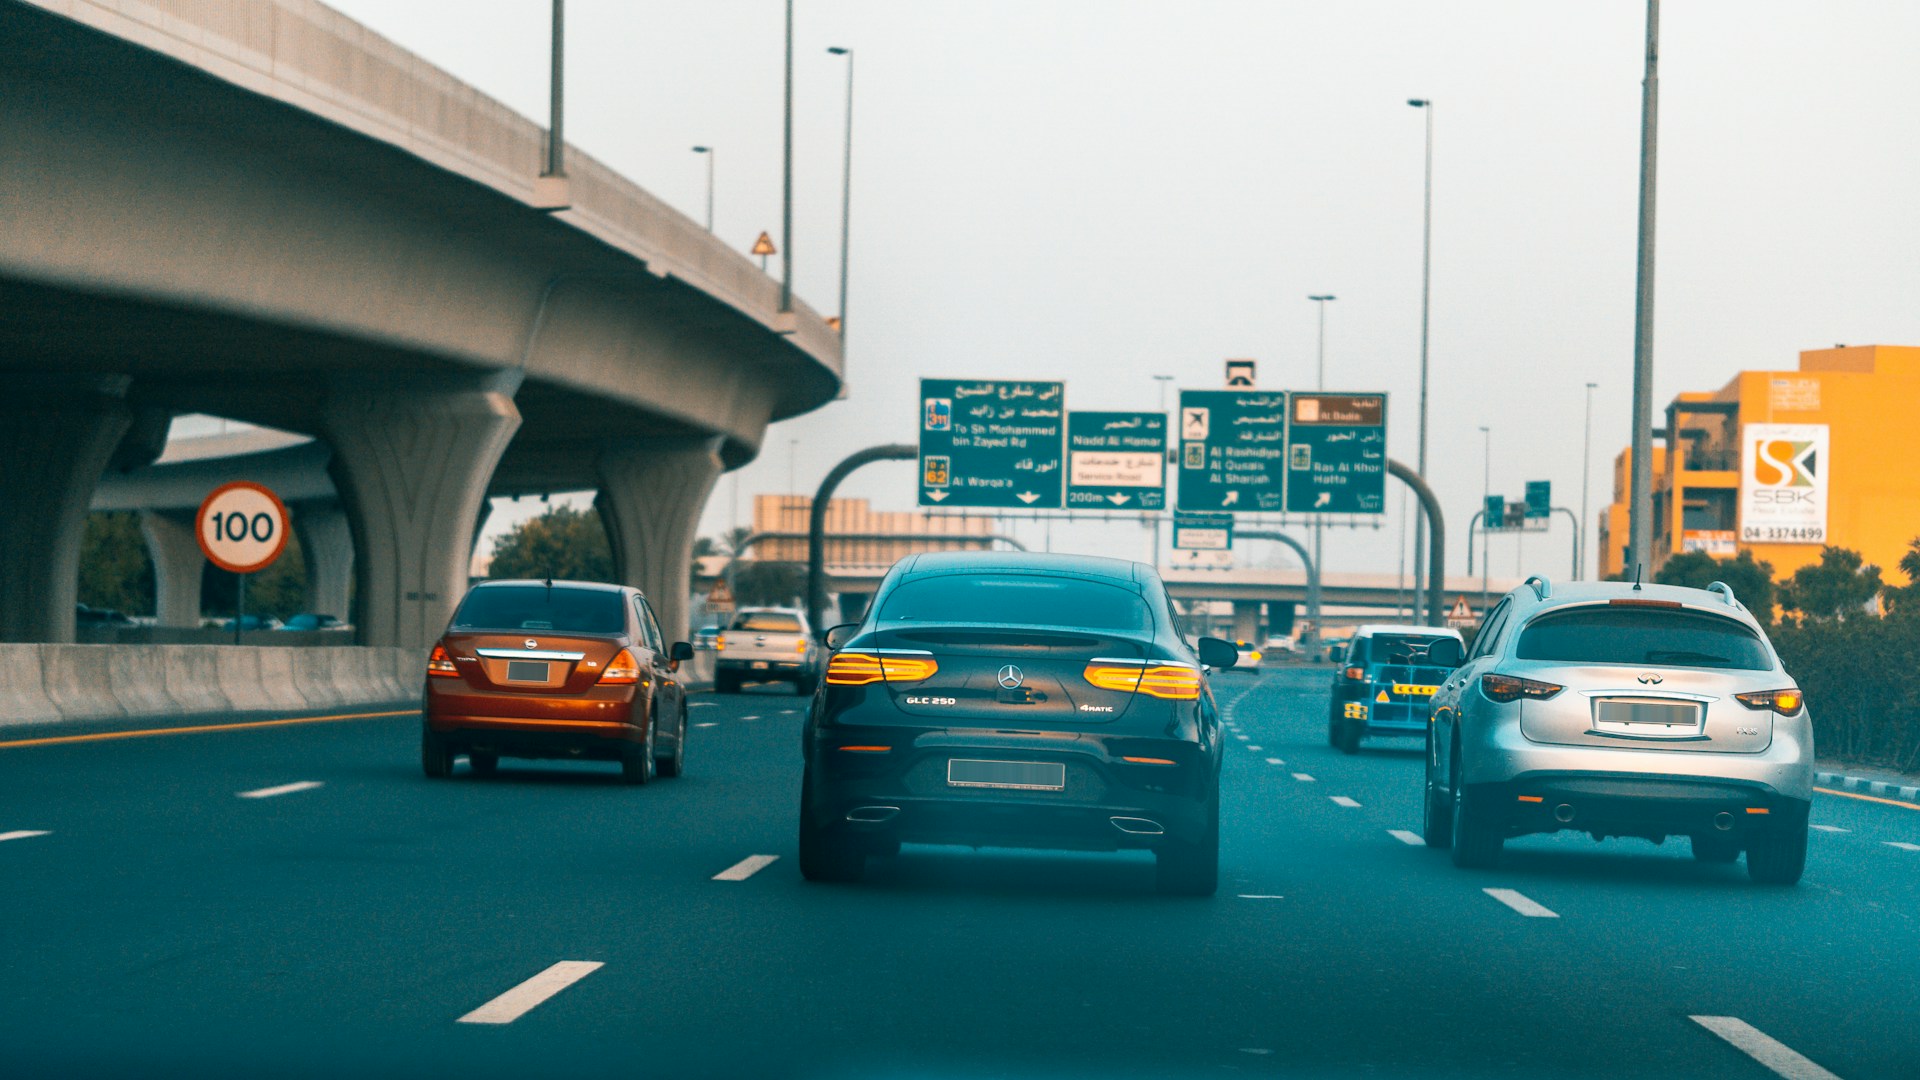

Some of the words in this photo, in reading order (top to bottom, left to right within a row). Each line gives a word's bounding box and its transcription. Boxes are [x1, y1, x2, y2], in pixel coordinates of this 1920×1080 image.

[999, 384, 1034, 400] شارع
[1021, 407, 1059, 418] محمد
[954, 424, 967, 434] To
[971, 424, 986, 434] Sh
[989, 424, 1056, 436] Mohammed
[952, 436, 970, 446] bin
[973, 436, 1008, 449] Zayed
[1010, 437, 1027, 448] Rd
[1073, 435, 1105, 446] Nadd
[1107, 435, 1120, 446] Al
[1123, 436, 1161, 447] Hamar
[1210, 446, 1222, 457] Al
[1225, 446, 1281, 459] Rashidiya
[1210, 460, 1222, 470] Al
[1225, 460, 1265, 471] Qusais
[1313, 462, 1334, 473] Ras
[1338, 462, 1349, 473] Al
[1354, 462, 1380, 473] Khor
[927, 470, 946, 483] 62
[952, 476, 964, 486] Al
[1078, 471, 1113, 480] Service
[1116, 472, 1142, 481] Road
[1210, 473, 1222, 483] Al
[1225, 473, 1270, 485] Sharjah
[1313, 475, 1347, 485] Hatta
[1069, 492, 1104, 503] 200m
[1753, 489, 1815, 505] SBK
[211, 511, 274, 543] 100
[906, 697, 929, 705] GLC
[931, 697, 956, 705] 250
[1080, 703, 1113, 713] 4MATIC
